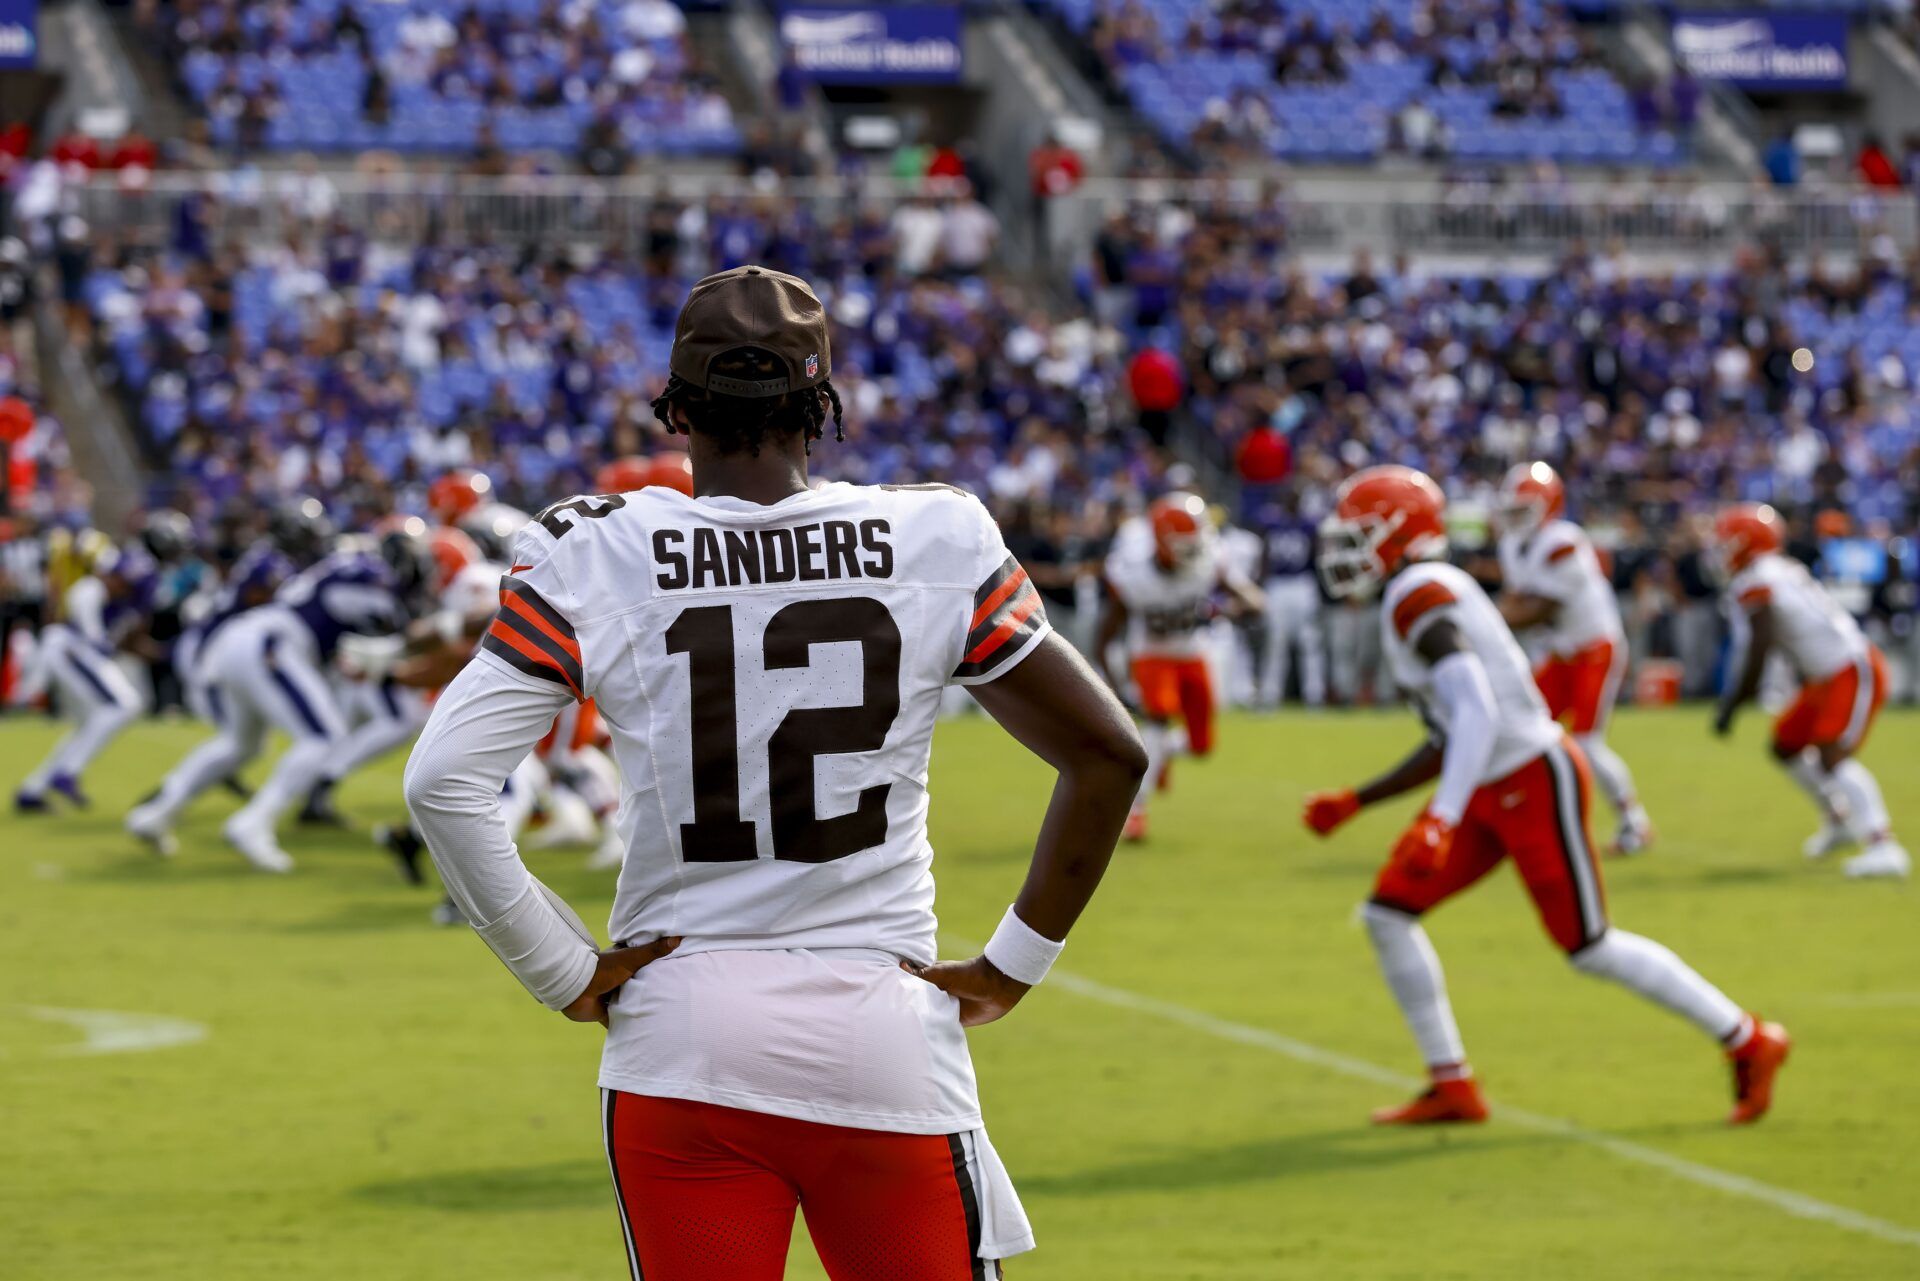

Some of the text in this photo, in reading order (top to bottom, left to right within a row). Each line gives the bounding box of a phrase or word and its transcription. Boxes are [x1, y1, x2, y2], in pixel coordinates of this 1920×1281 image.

[531, 493, 627, 541] 2
[652, 518, 894, 590] SANDERS
[665, 596, 902, 864] 12
